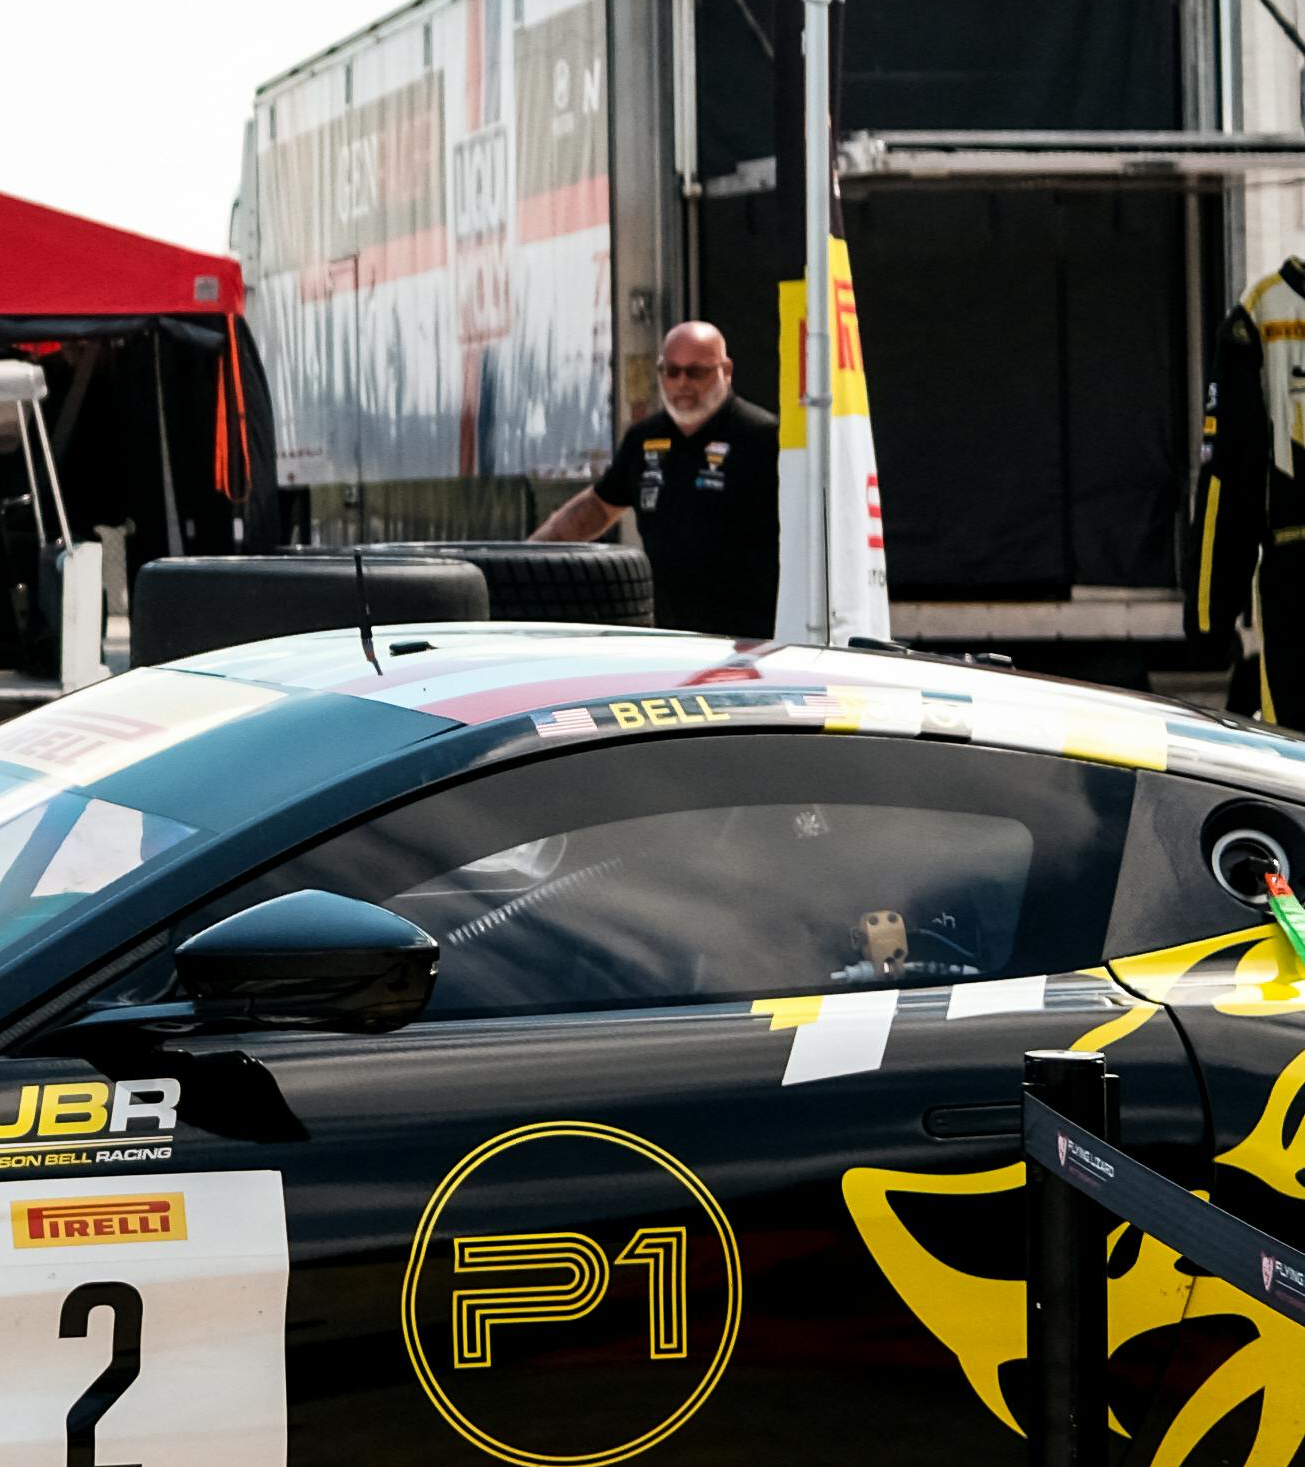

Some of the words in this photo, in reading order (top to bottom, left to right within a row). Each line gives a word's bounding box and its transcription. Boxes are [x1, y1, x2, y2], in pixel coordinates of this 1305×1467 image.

[608, 694, 731, 731] BELL
[44, 1152, 92, 1167] BELL
[95, 1147, 173, 1164] RACING
[27, 1200, 172, 1239] PIRELLI
[453, 1227, 688, 1369] P1
